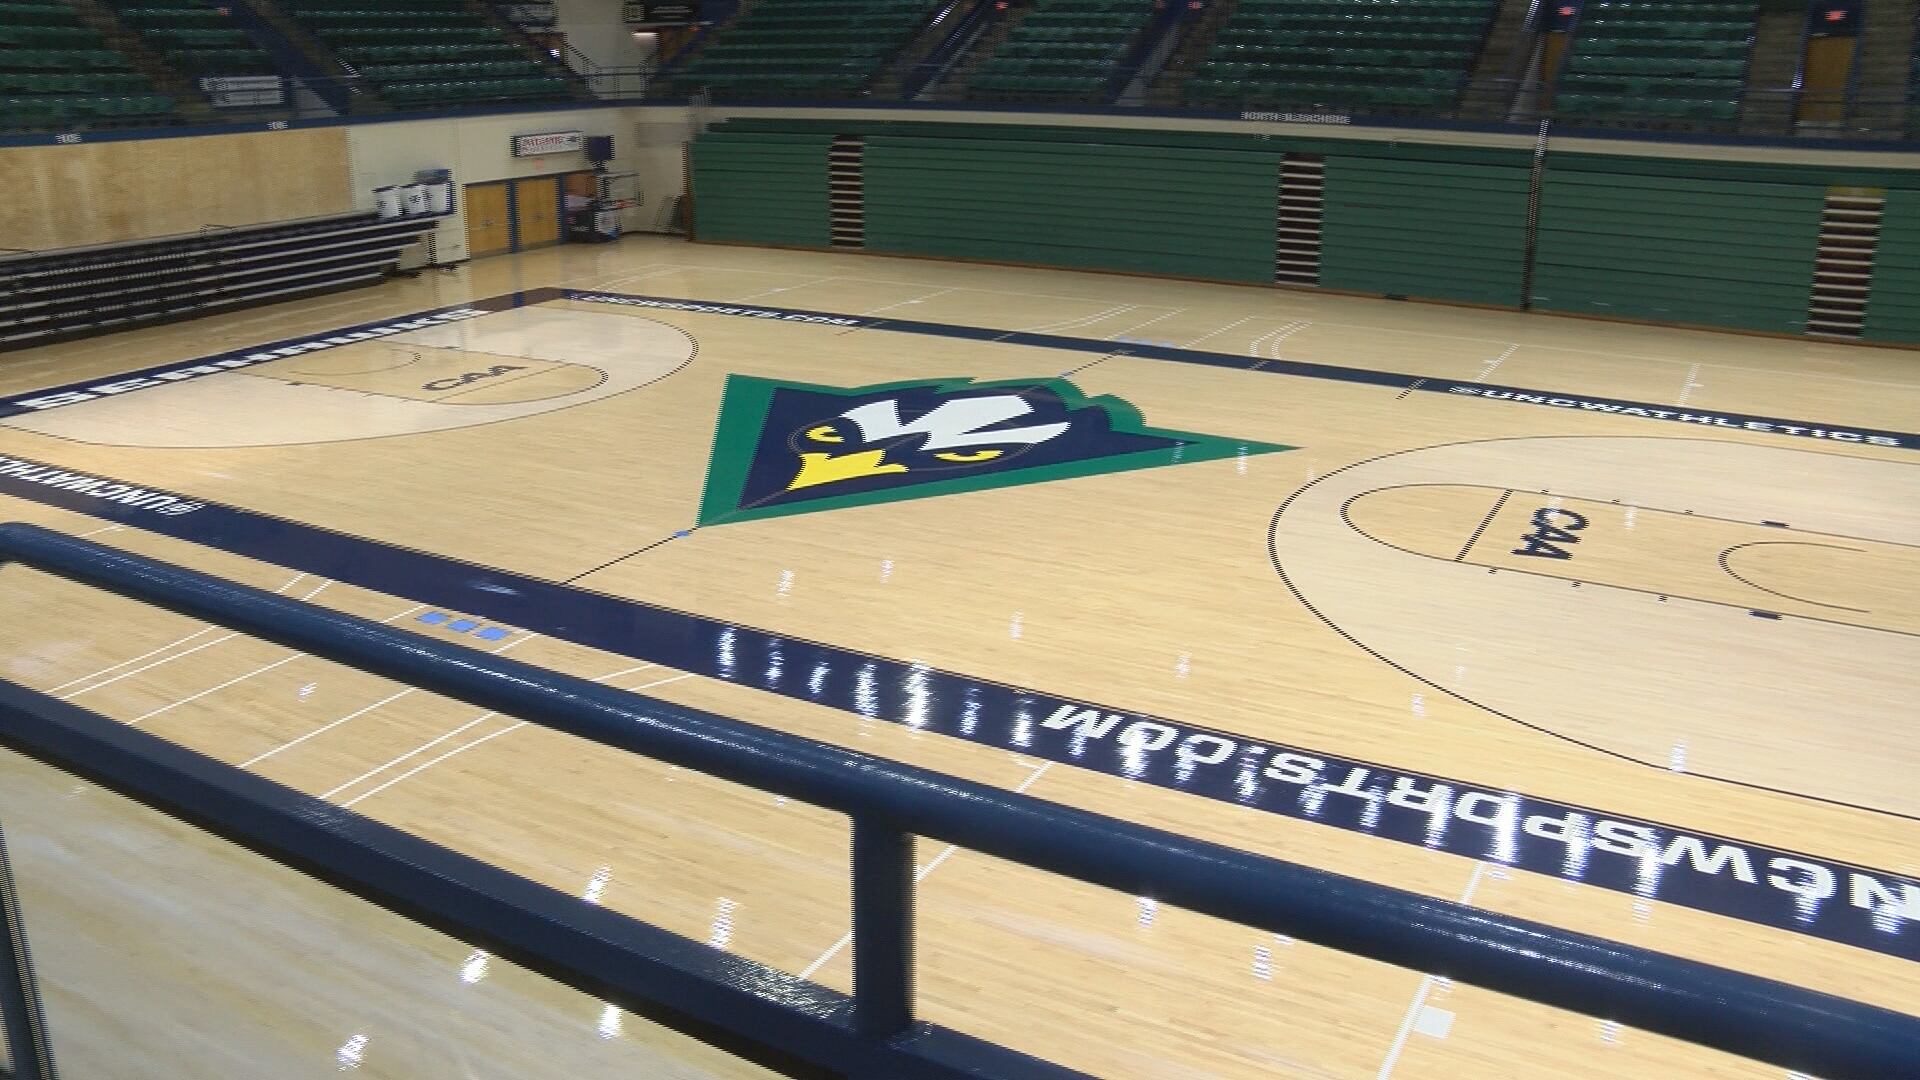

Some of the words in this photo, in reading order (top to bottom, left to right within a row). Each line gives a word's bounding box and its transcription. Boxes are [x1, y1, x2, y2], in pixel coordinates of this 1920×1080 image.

[1240, 111, 1281, 121] NORTH
[1282, 112, 1352, 124] BLEACHERS
[14, 307, 487, 410] SEAHAWKS
[421, 364, 531, 391] CAA
[1448, 386, 1902, 447] @UNCWATHLETICS
[0, 457, 206, 518] @UNCWATHL
[1509, 508, 1590, 560] CAA
